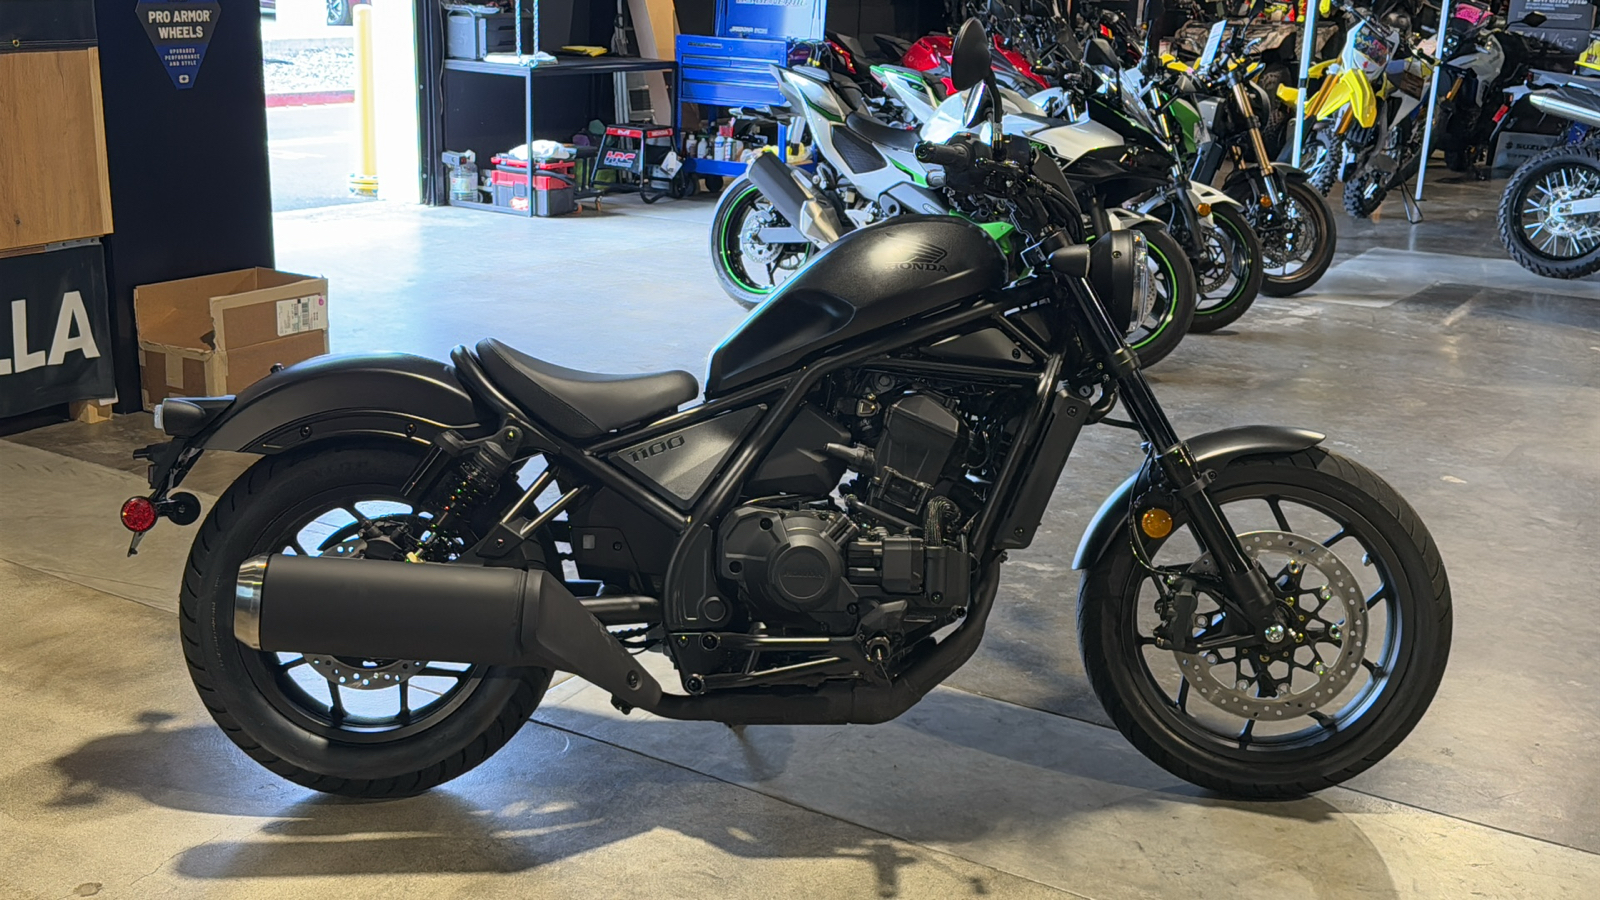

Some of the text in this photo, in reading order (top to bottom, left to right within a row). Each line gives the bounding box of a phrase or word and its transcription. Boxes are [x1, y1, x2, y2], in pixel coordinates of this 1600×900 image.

[148, 9, 211, 24] PRO ARMOR
[157, 25, 204, 39] WHEELS
[1515, 143, 1550, 152] SUZUK
[603, 150, 636, 168] HRC
[628, 434, 686, 463] 1100
